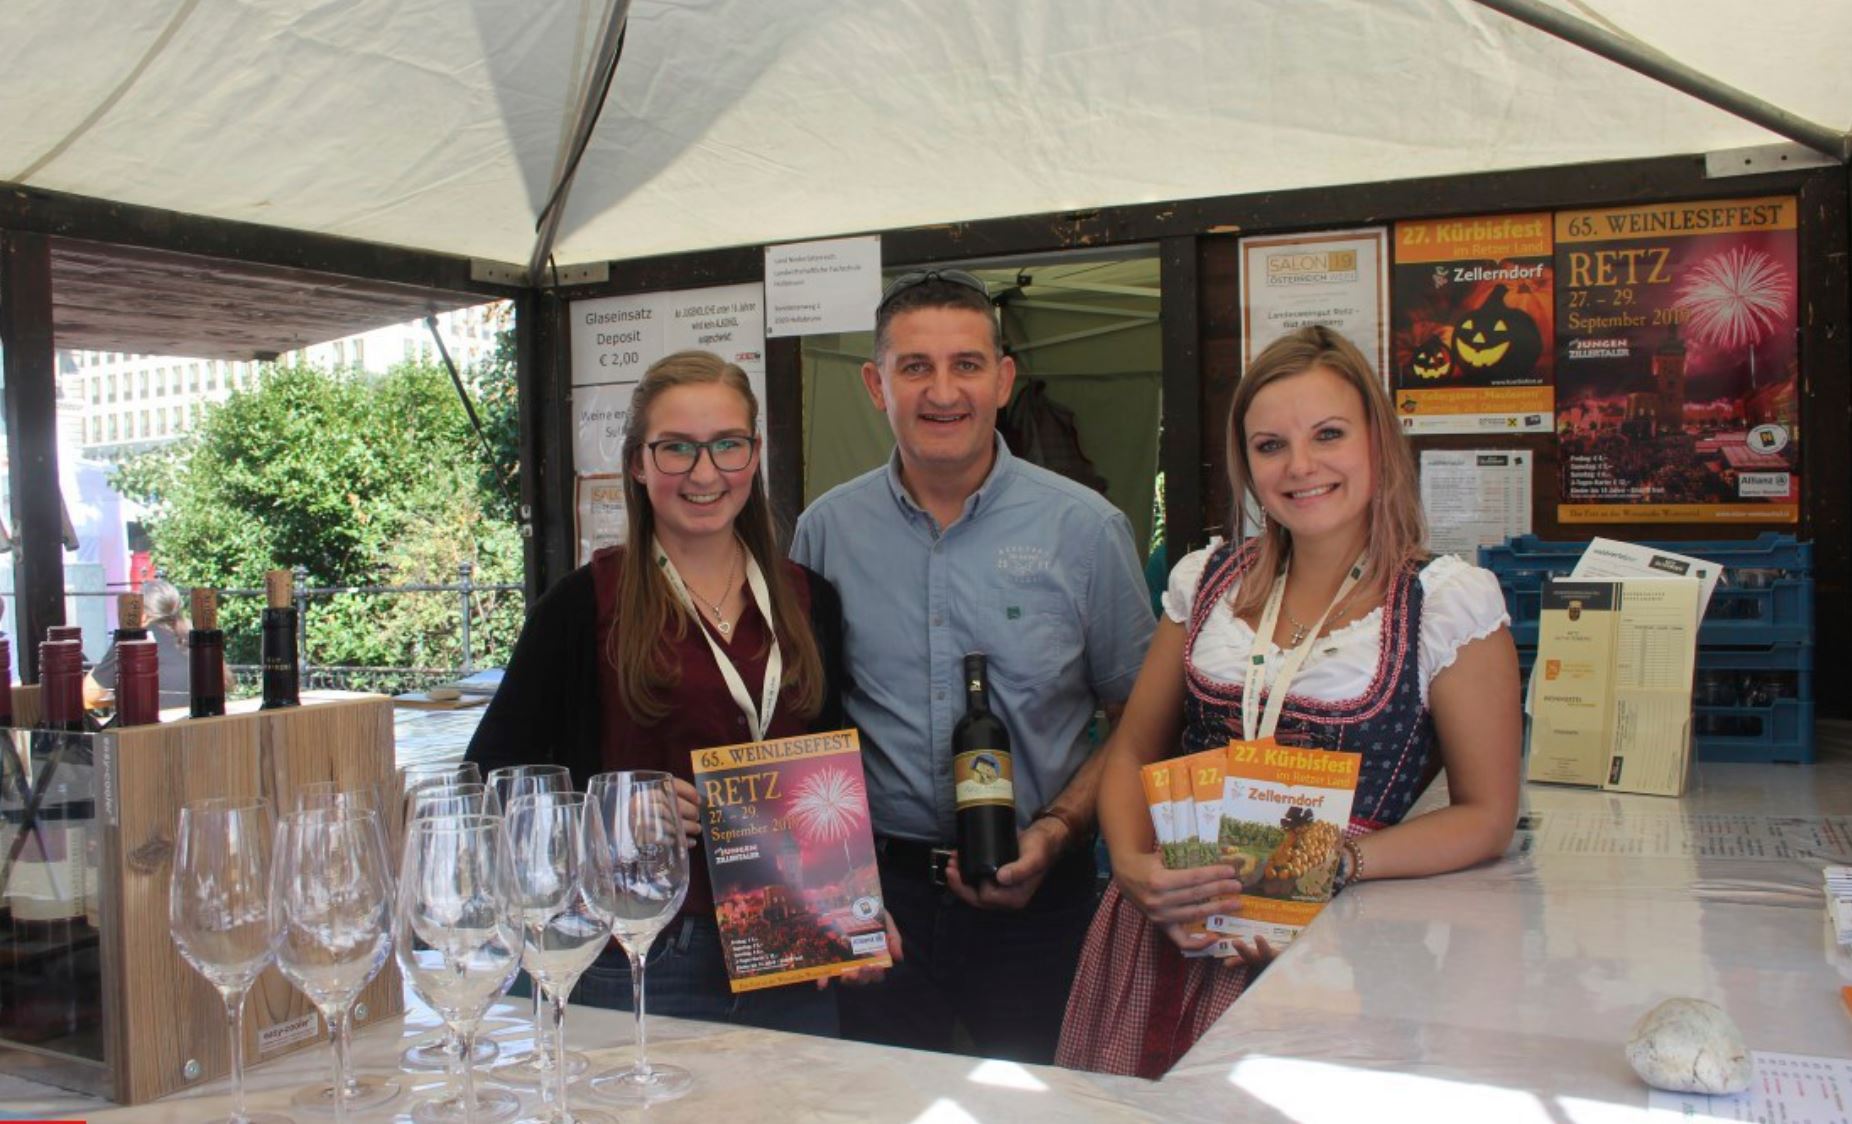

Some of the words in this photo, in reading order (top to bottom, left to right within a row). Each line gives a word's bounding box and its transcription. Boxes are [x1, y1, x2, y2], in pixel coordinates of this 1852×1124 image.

[1568, 216, 1598, 237] 65.
[1606, 204, 1783, 233] WEINLESEFEST
[1403, 226, 1430, 245] 27.
[1436, 219, 1543, 242] Kürbisfest
[1453, 247, 1469, 257] im
[1514, 240, 1544, 254] Land
[1270, 255, 1327, 272] SALON
[1454, 263, 1544, 282] Zellerndorf
[1568, 248, 1672, 287] RETZ
[1568, 291, 1590, 308] 27.
[1612, 288, 1637, 306] 29.
[585, 307, 652, 325] Glaseinsatz
[1568, 311, 1647, 334] September
[597, 331, 641, 346] Deposit
[600, 354, 608, 366] €
[611, 352, 640, 366] 2,00
[581, 411, 612, 422] Weine
[701, 751, 725, 769] 65.
[729, 734, 852, 765] WEINLESEFEST
[1234, 744, 1260, 764] 27.
[1263, 748, 1354, 774] Kürbisfest
[1198, 767, 1222, 786] 27.
[1276, 770, 1290, 780] im
[704, 770, 783, 808] RETZ
[1247, 786, 1325, 807] Zellerndorf
[708, 809, 726, 826] 27.
[741, 805, 760, 821] 29.
[710, 822, 769, 844] September
